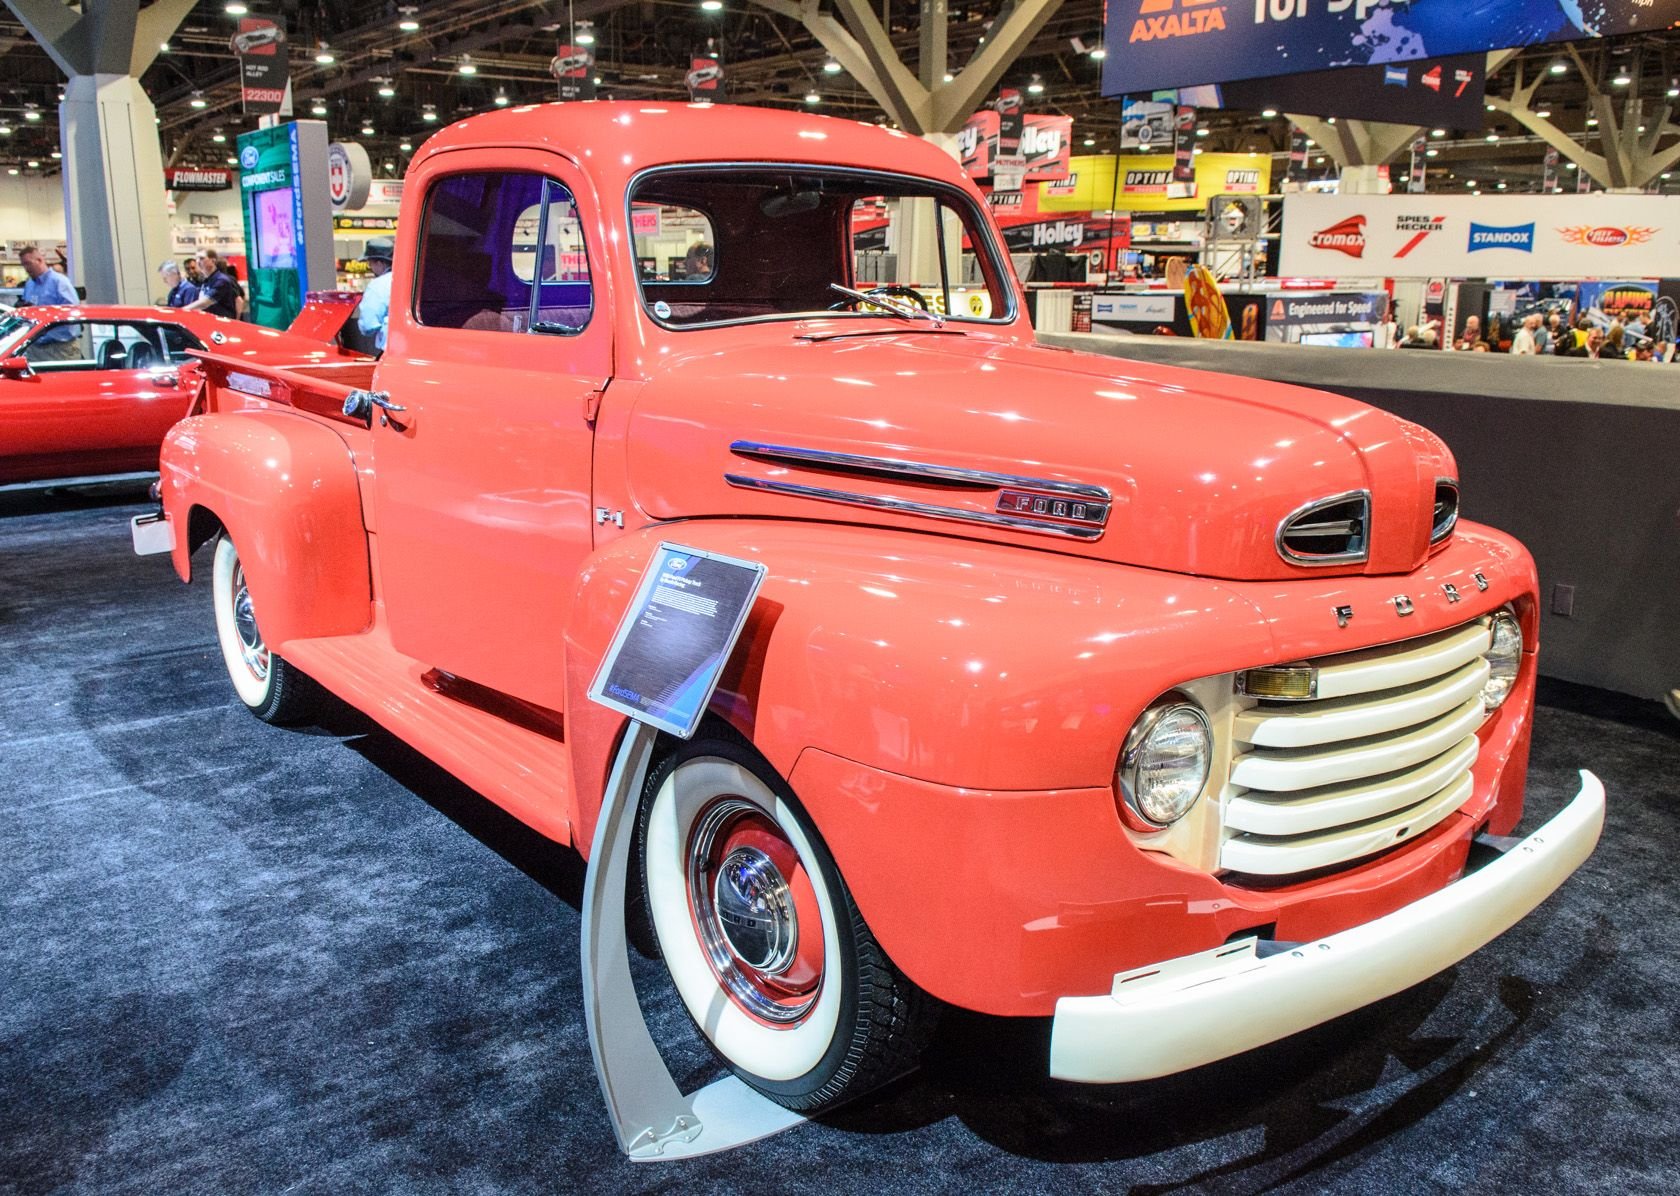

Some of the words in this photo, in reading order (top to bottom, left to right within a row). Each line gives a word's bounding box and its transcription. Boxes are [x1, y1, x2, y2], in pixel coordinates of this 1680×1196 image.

[1129, 7, 1226, 43] AXALTA
[247, 89, 282, 102] 22300
[173, 171, 227, 187] FLOWMASTER
[1033, 221, 1083, 247] Holley
[1397, 223, 1443, 231] HECKER
[1473, 232, 1529, 243] STANDOX
[1289, 301, 1335, 318] Engineered
[1335, 301, 1347, 315] for
[1347, 300, 1373, 317] Speed
[596, 506, 624, 528] F-1
[1016, 496, 1087, 519] FORD
[1331, 572, 1488, 628] FORD
